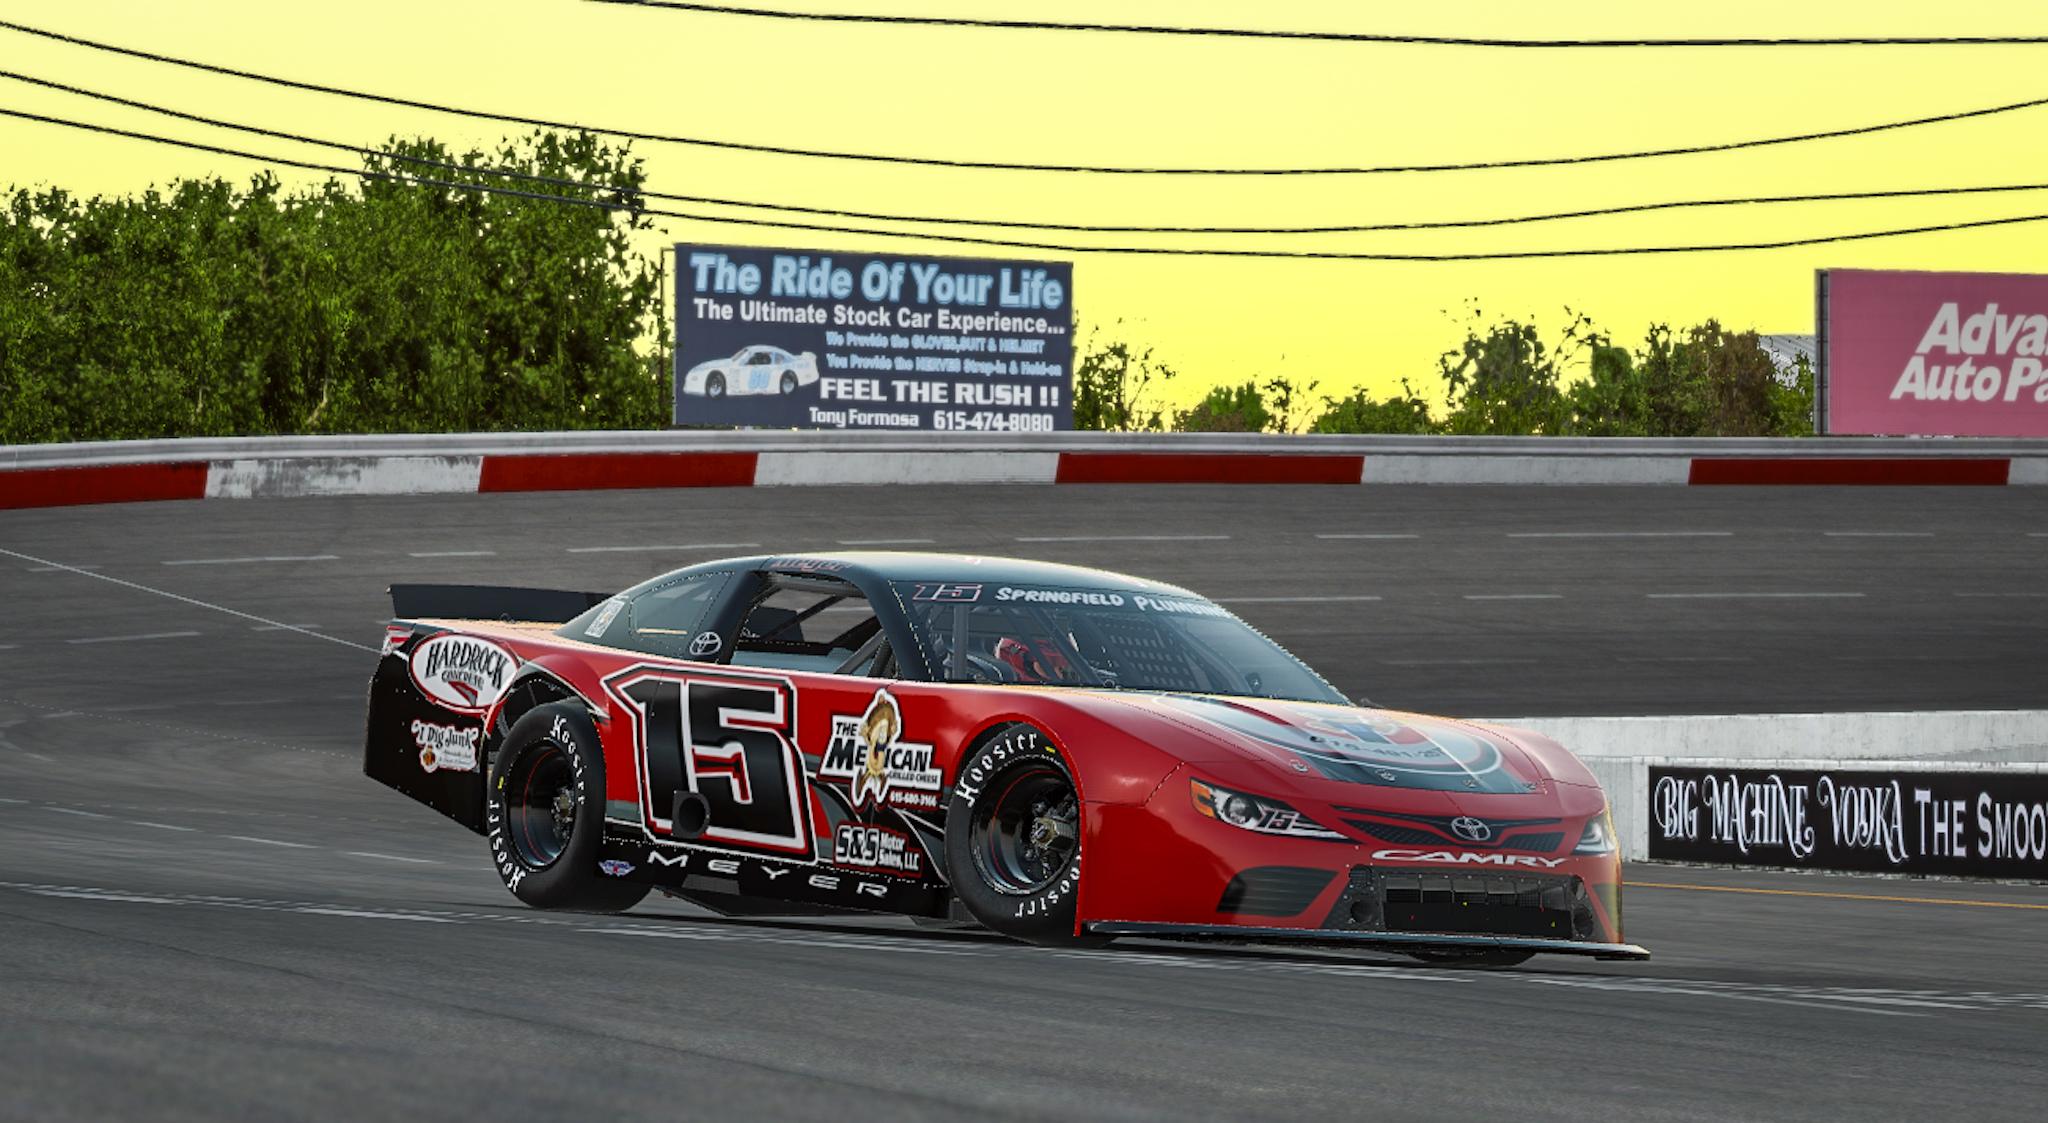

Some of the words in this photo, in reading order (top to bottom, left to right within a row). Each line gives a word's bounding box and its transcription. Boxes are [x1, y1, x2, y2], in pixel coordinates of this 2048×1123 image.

[689, 252, 761, 295] The
[770, 255, 853, 299] Ride
[861, 260, 905, 302] Of
[909, 263, 993, 306] Your
[1000, 268, 1063, 310] Life
[694, 298, 733, 320] The
[740, 300, 827, 324] Ultimate
[834, 304, 891, 327] Stock
[897, 307, 932, 328] Car
[938, 309, 1065, 334] Experience...
[1915, 302, 2048, 356] Adva
[890, 334, 910, 349] the
[987, 337, 997, 352] &
[894, 356, 914, 370] the
[1009, 360, 1019, 375] &
[1889, 356, 2001, 401] Auto
[820, 377, 887, 401] FEEL
[891, 380, 949, 404] THE
[955, 383, 1032, 406] RUSH
[809, 406, 846, 428] Tony
[848, 408, 919, 427] Formosa
[933, 410, 1054, 431] 615-474-8080
[912, 583, 983, 602] 15
[995, 587, 1124, 607] SPRINGFIELD
[425, 640, 510, 689] HARDROCK
[428, 726, 445, 750] Dig
[836, 721, 858, 737] THE
[550, 714, 588, 805] Hoosier
[612, 670, 809, 855] 15
[825, 737, 929, 772] MEICAN
[954, 732, 1037, 808] Hoosier
[1254, 802, 1300, 831] 15
[1654, 775, 1699, 841] BIG
[1702, 774, 1815, 859] MACHINE
[1817, 775, 1909, 863] VODKA
[1976, 791, 2048, 860] SMOO
[488, 799, 526, 892] Hoosier
[835, 825, 879, 867] S&S
[880, 832, 905, 851] Motor
[1372, 850, 1568, 868] CAMRY
[648, 850, 888, 898] MEYER
[904, 850, 920, 871] LLC
[1014, 844, 1081, 918] oosier
